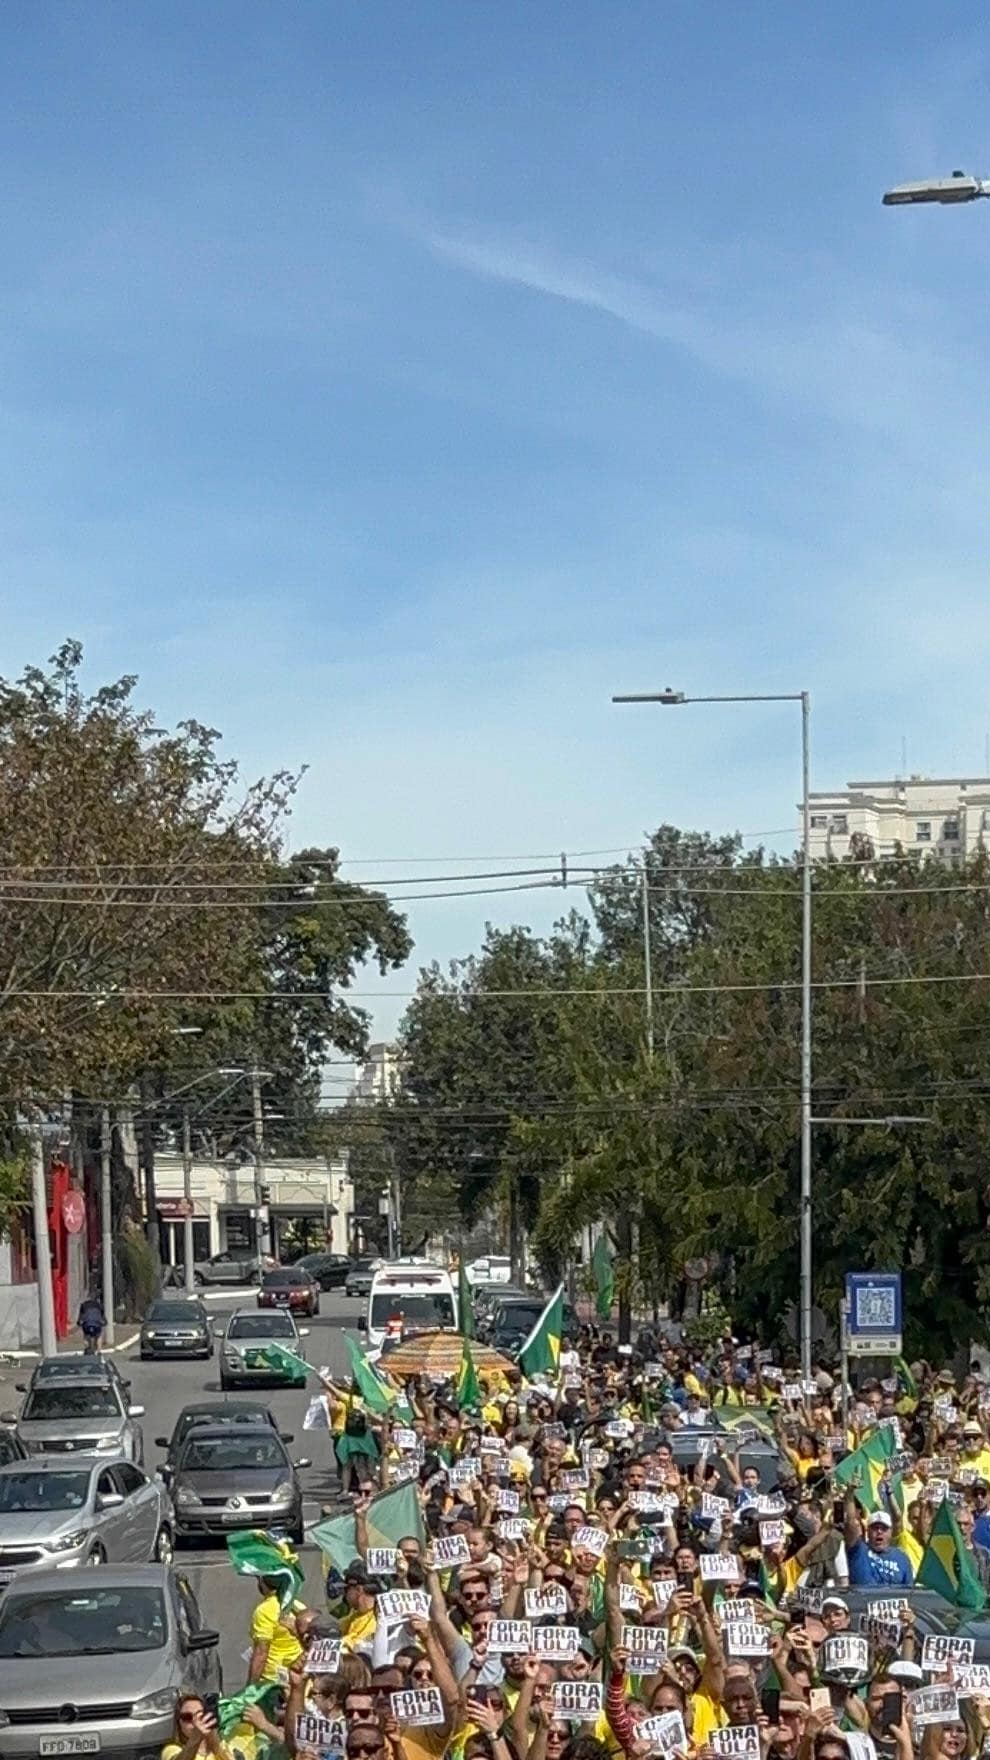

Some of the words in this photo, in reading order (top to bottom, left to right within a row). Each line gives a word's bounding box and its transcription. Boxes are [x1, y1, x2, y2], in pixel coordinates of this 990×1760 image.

[534, 1628, 577, 1639] FORA
[624, 1628, 665, 1641] FORA
[926, 1637, 970, 1650] FORA
[552, 1684, 600, 1697] FORA
[393, 1689, 438, 1706] FORA
[395, 1701, 440, 1717] LULA
[297, 1714, 343, 1734] FORA
[709, 1727, 757, 1741] FORA
